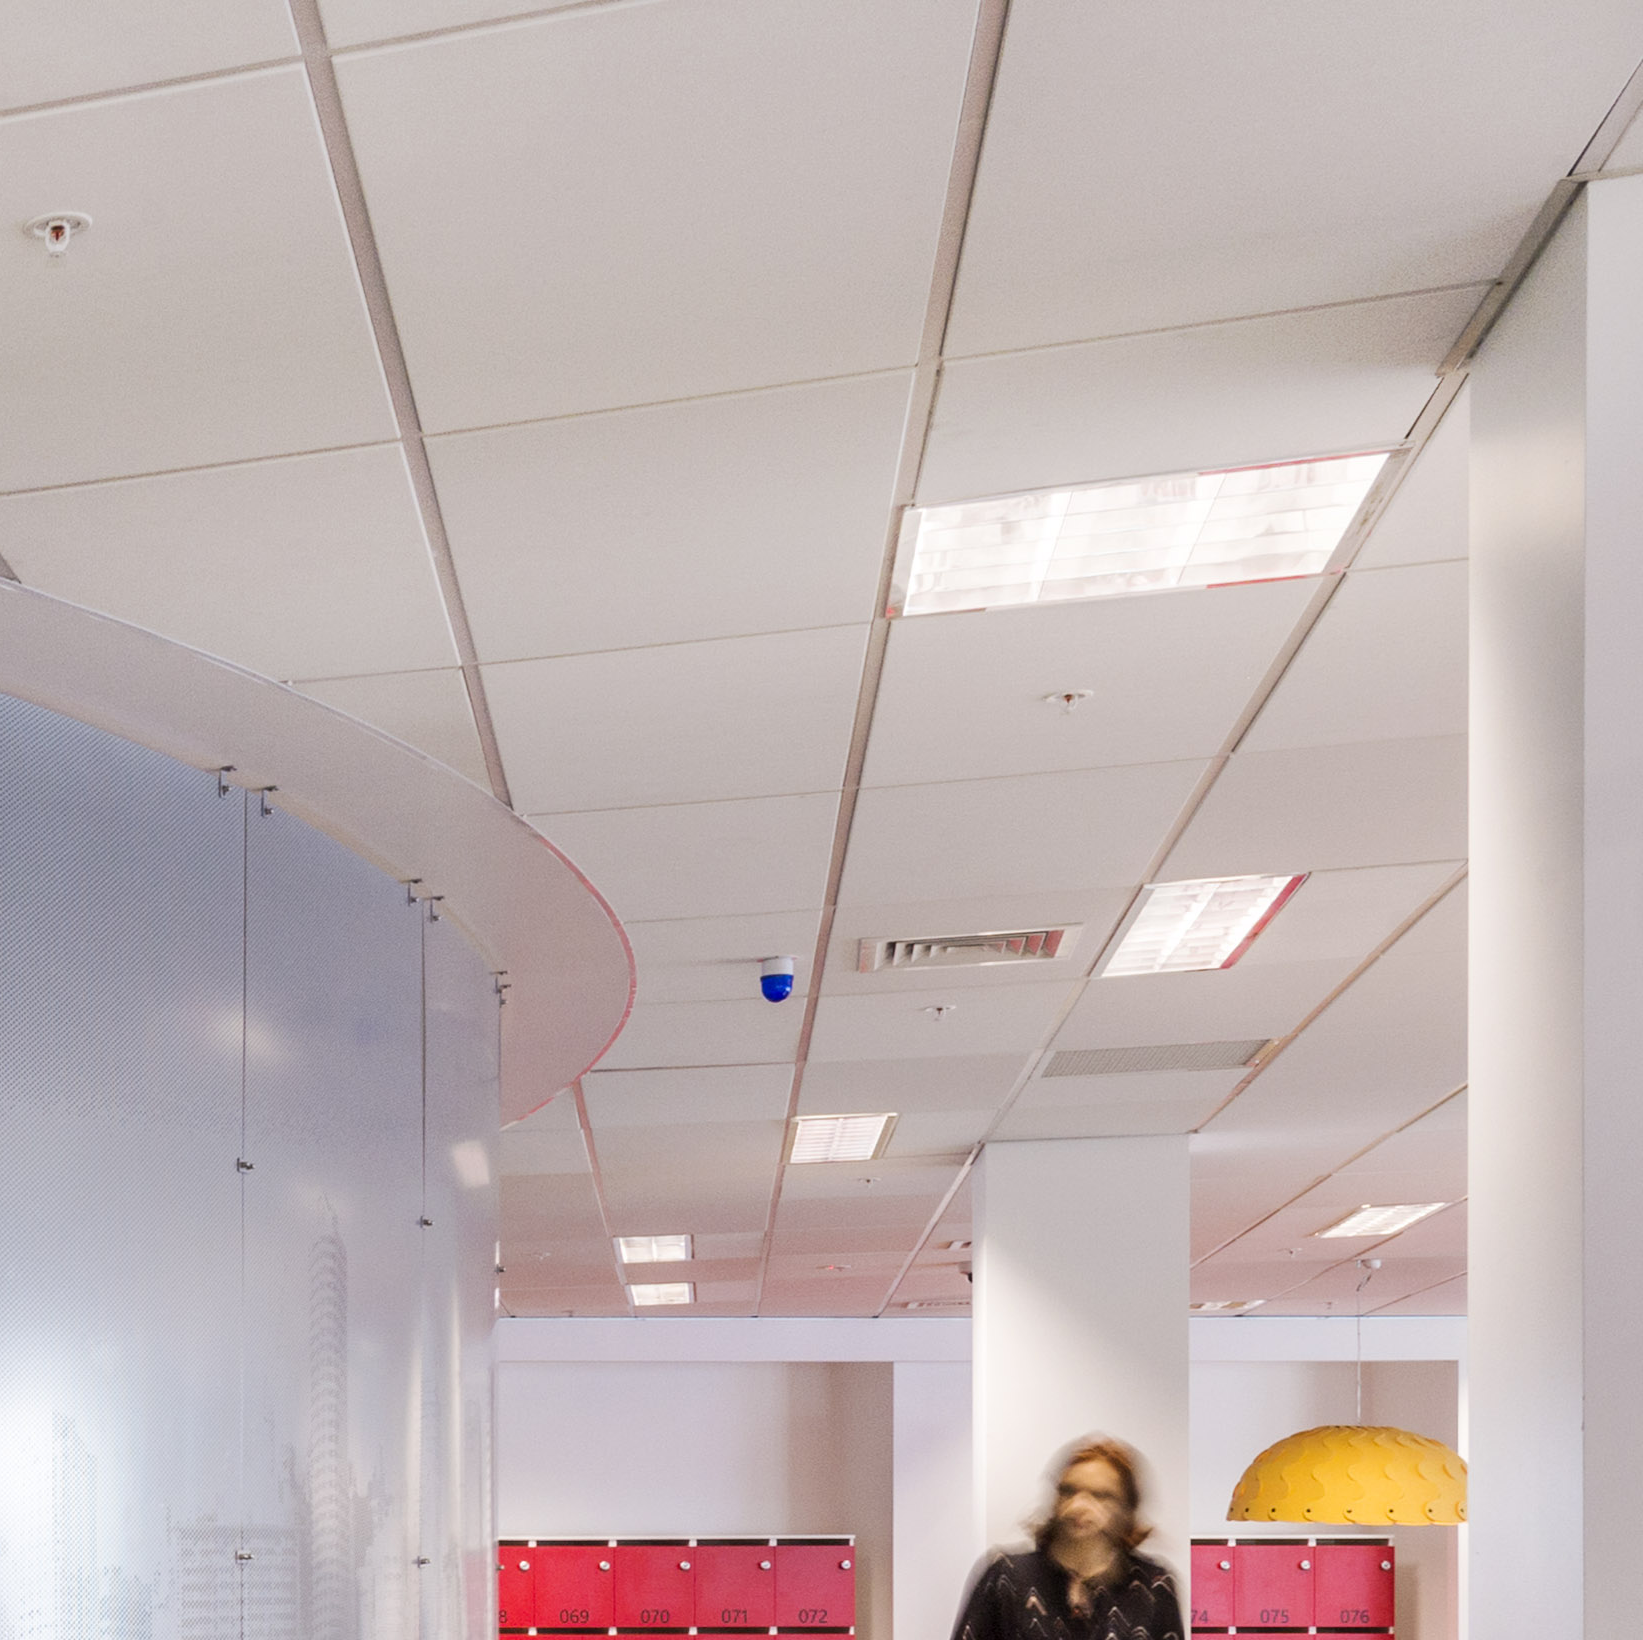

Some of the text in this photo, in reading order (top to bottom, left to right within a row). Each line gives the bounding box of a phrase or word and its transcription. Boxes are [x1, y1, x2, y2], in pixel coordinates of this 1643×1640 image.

[560, 1609, 589, 1624] 069
[641, 1609, 670, 1624] 070
[721, 1609, 747, 1623] 071
[798, 1609, 827, 1624] 072
[1192, 1609, 1208, 1624] 74
[1260, 1609, 1289, 1623] 075
[1341, 1609, 1370, 1624] 076
